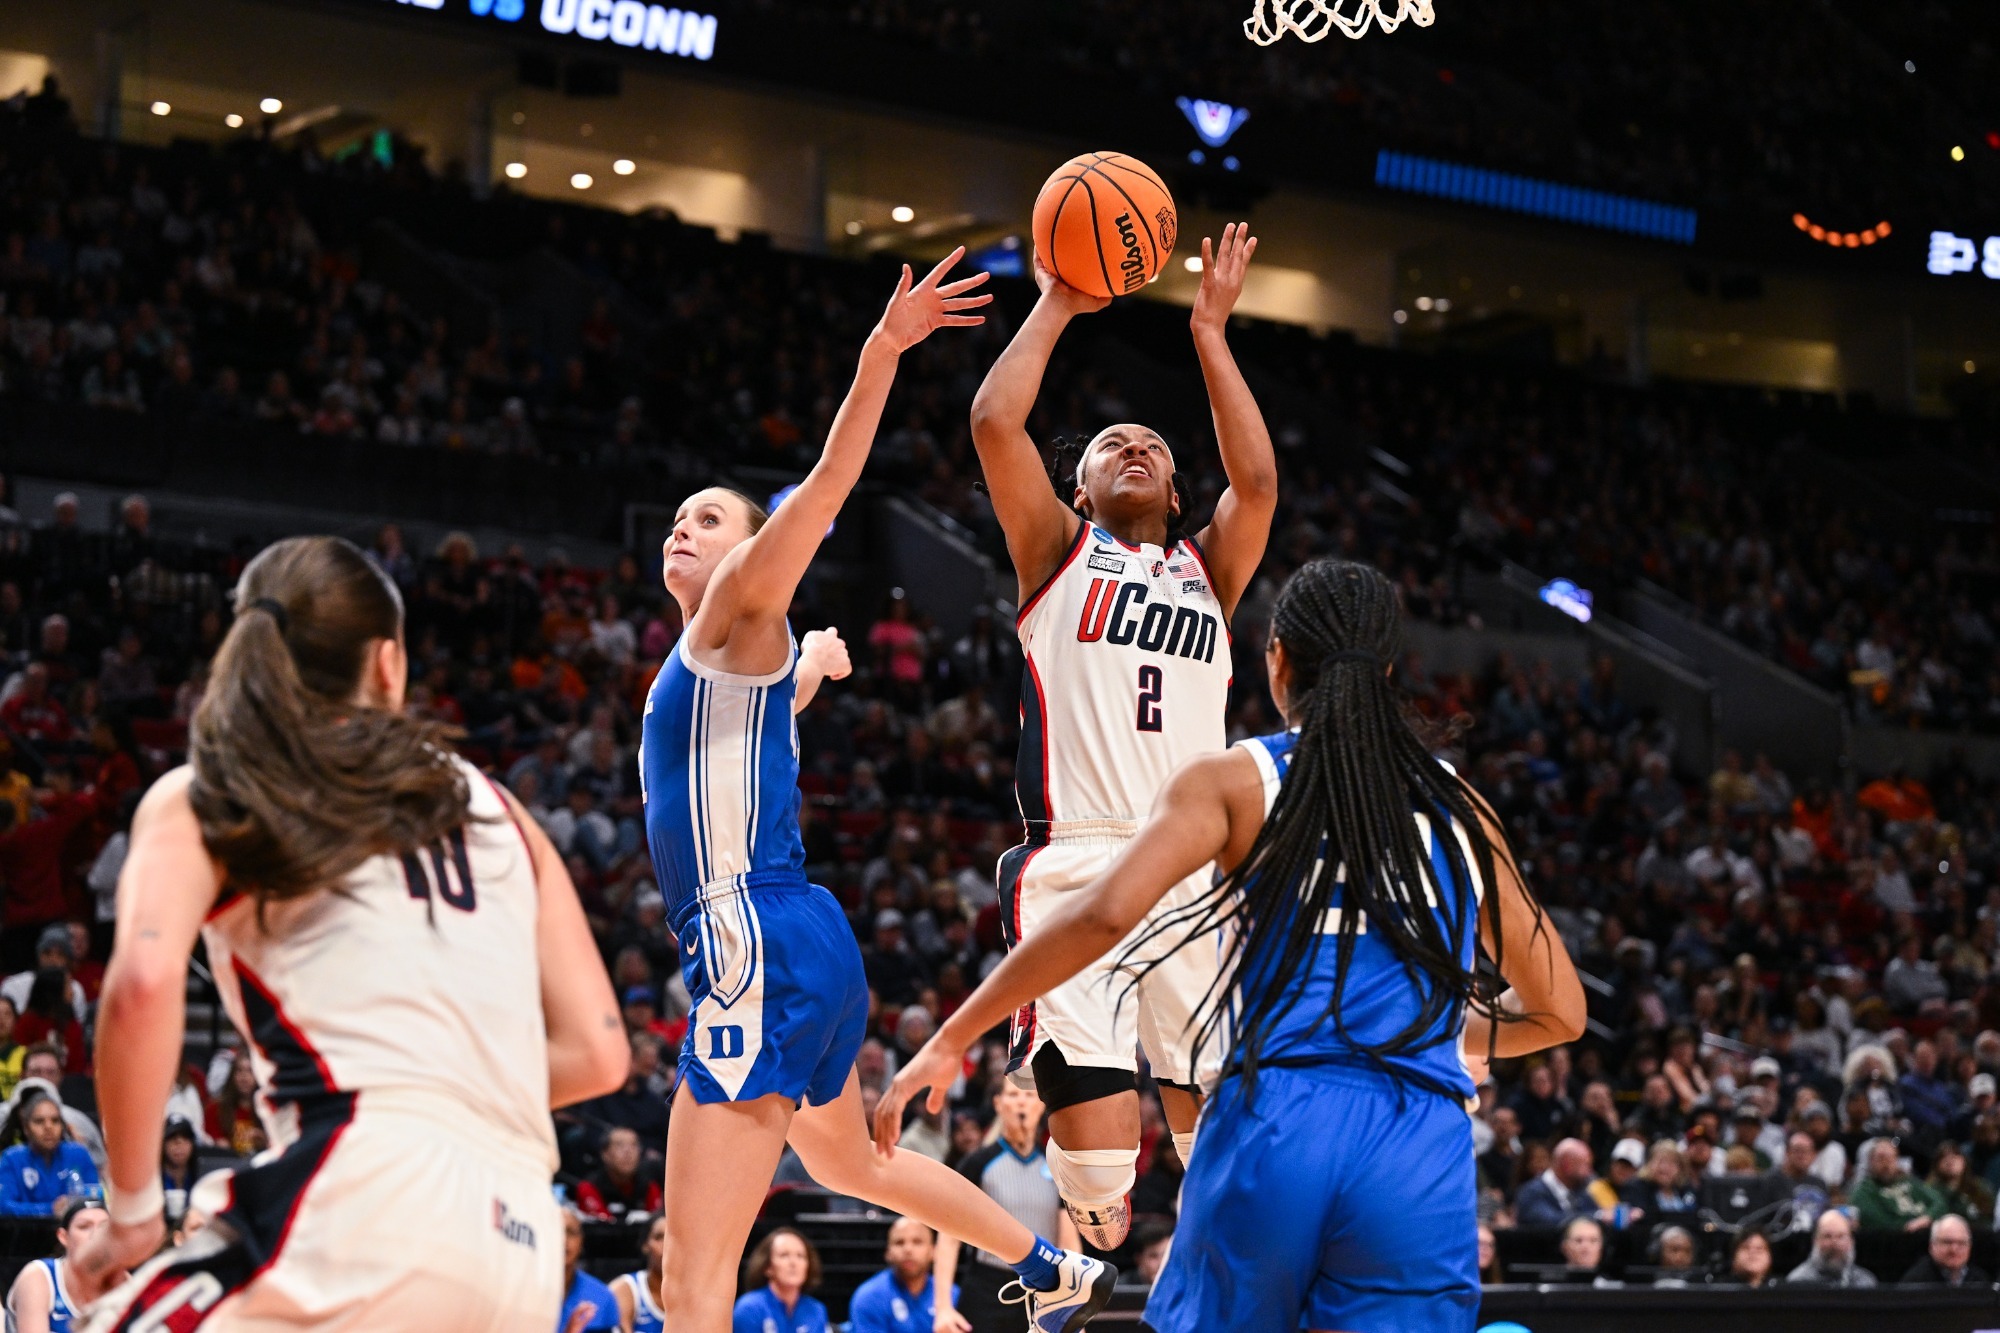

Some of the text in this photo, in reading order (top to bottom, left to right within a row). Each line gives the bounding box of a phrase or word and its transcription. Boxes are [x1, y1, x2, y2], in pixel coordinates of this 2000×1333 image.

[540, 0, 718, 61] UCONN
[1115, 212, 1146, 293] Wilson
[1089, 562, 1123, 573] CHANGE
[1182, 585, 1207, 593] EAST
[1077, 578, 1217, 664] UConn
[1136, 664, 1163, 733] 2
[707, 1024, 745, 1060] D
